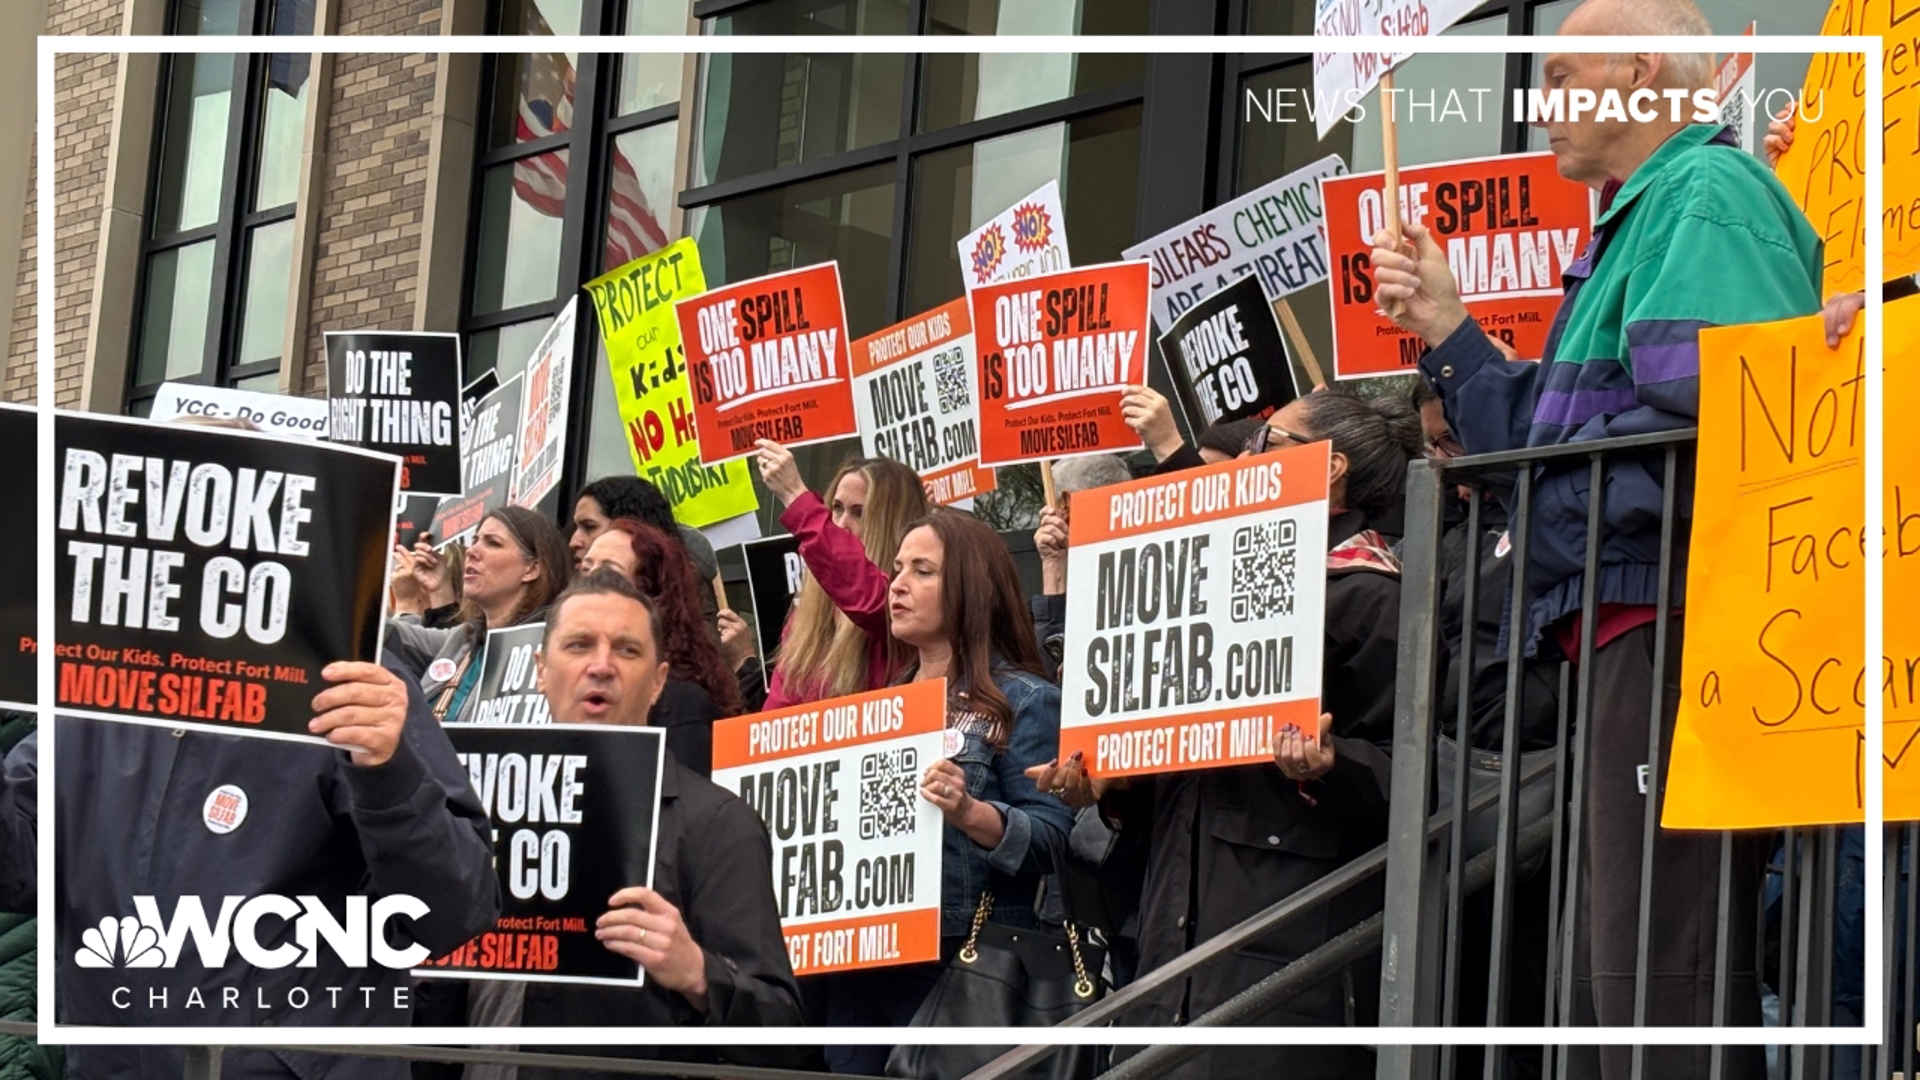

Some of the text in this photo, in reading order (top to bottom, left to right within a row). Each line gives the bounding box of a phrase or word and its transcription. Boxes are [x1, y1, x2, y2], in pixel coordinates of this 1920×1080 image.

[1019, 213, 1043, 240] NO!
[1234, 165, 1344, 248] CHEMIC
[1435, 174, 1539, 235] SPILL
[592, 251, 684, 340] PROTECT
[1341, 228, 1580, 305] IS MANY
[637, 326, 660, 350] our
[697, 287, 810, 355] ONE SPILL
[868, 312, 951, 366] PROTECT OUR KIDS
[996, 283, 1111, 347] ONE SPILL
[1179, 304, 1249, 383] REVOKE
[345, 350, 413, 396] DO THE
[694, 328, 838, 404] IS TOO MANY
[869, 361, 930, 429] MOVE
[983, 330, 1138, 400] IS TOO MANY
[1218, 356, 1259, 411] CO
[174, 397, 220, 418] YCC
[238, 405, 265, 426] Do
[270, 411, 327, 433] Good
[331, 398, 367, 441] RIGHT
[370, 399, 452, 446] THING
[475, 402, 501, 447] THE
[1740, 336, 1886, 472] Not
[469, 434, 514, 489] THING
[629, 409, 664, 466] NO
[1020, 421, 1100, 456] MOVE SILFAB
[59, 447, 316, 557] REVOKE
[1109, 462, 1282, 531] PROTECT OUR KIDS
[67, 540, 291, 645] THE CO
[1096, 533, 1210, 631] MOVE
[20, 637, 308, 684] Prect Our Kids. Protect Fort Mill.
[501, 643, 532, 692] DO
[1085, 622, 1294, 718] SILFAB.COM
[1700, 670, 1721, 708] a
[59, 662, 268, 724] MOVE SILFAB
[749, 696, 904, 757] PROTECT OUR KIDS
[1096, 715, 1275, 772] PROTECT FORT MILL
[456, 752, 588, 824] VOKE
[509, 828, 571, 901] CO
[778, 838, 915, 920] FAB.COM
[480, 932, 559, 970] SILFAB
[497, 917, 533, 931] rotect
[536, 917, 560, 931] Fort
[813, 928, 855, 967] FORT
[858, 923, 900, 962] MILL
